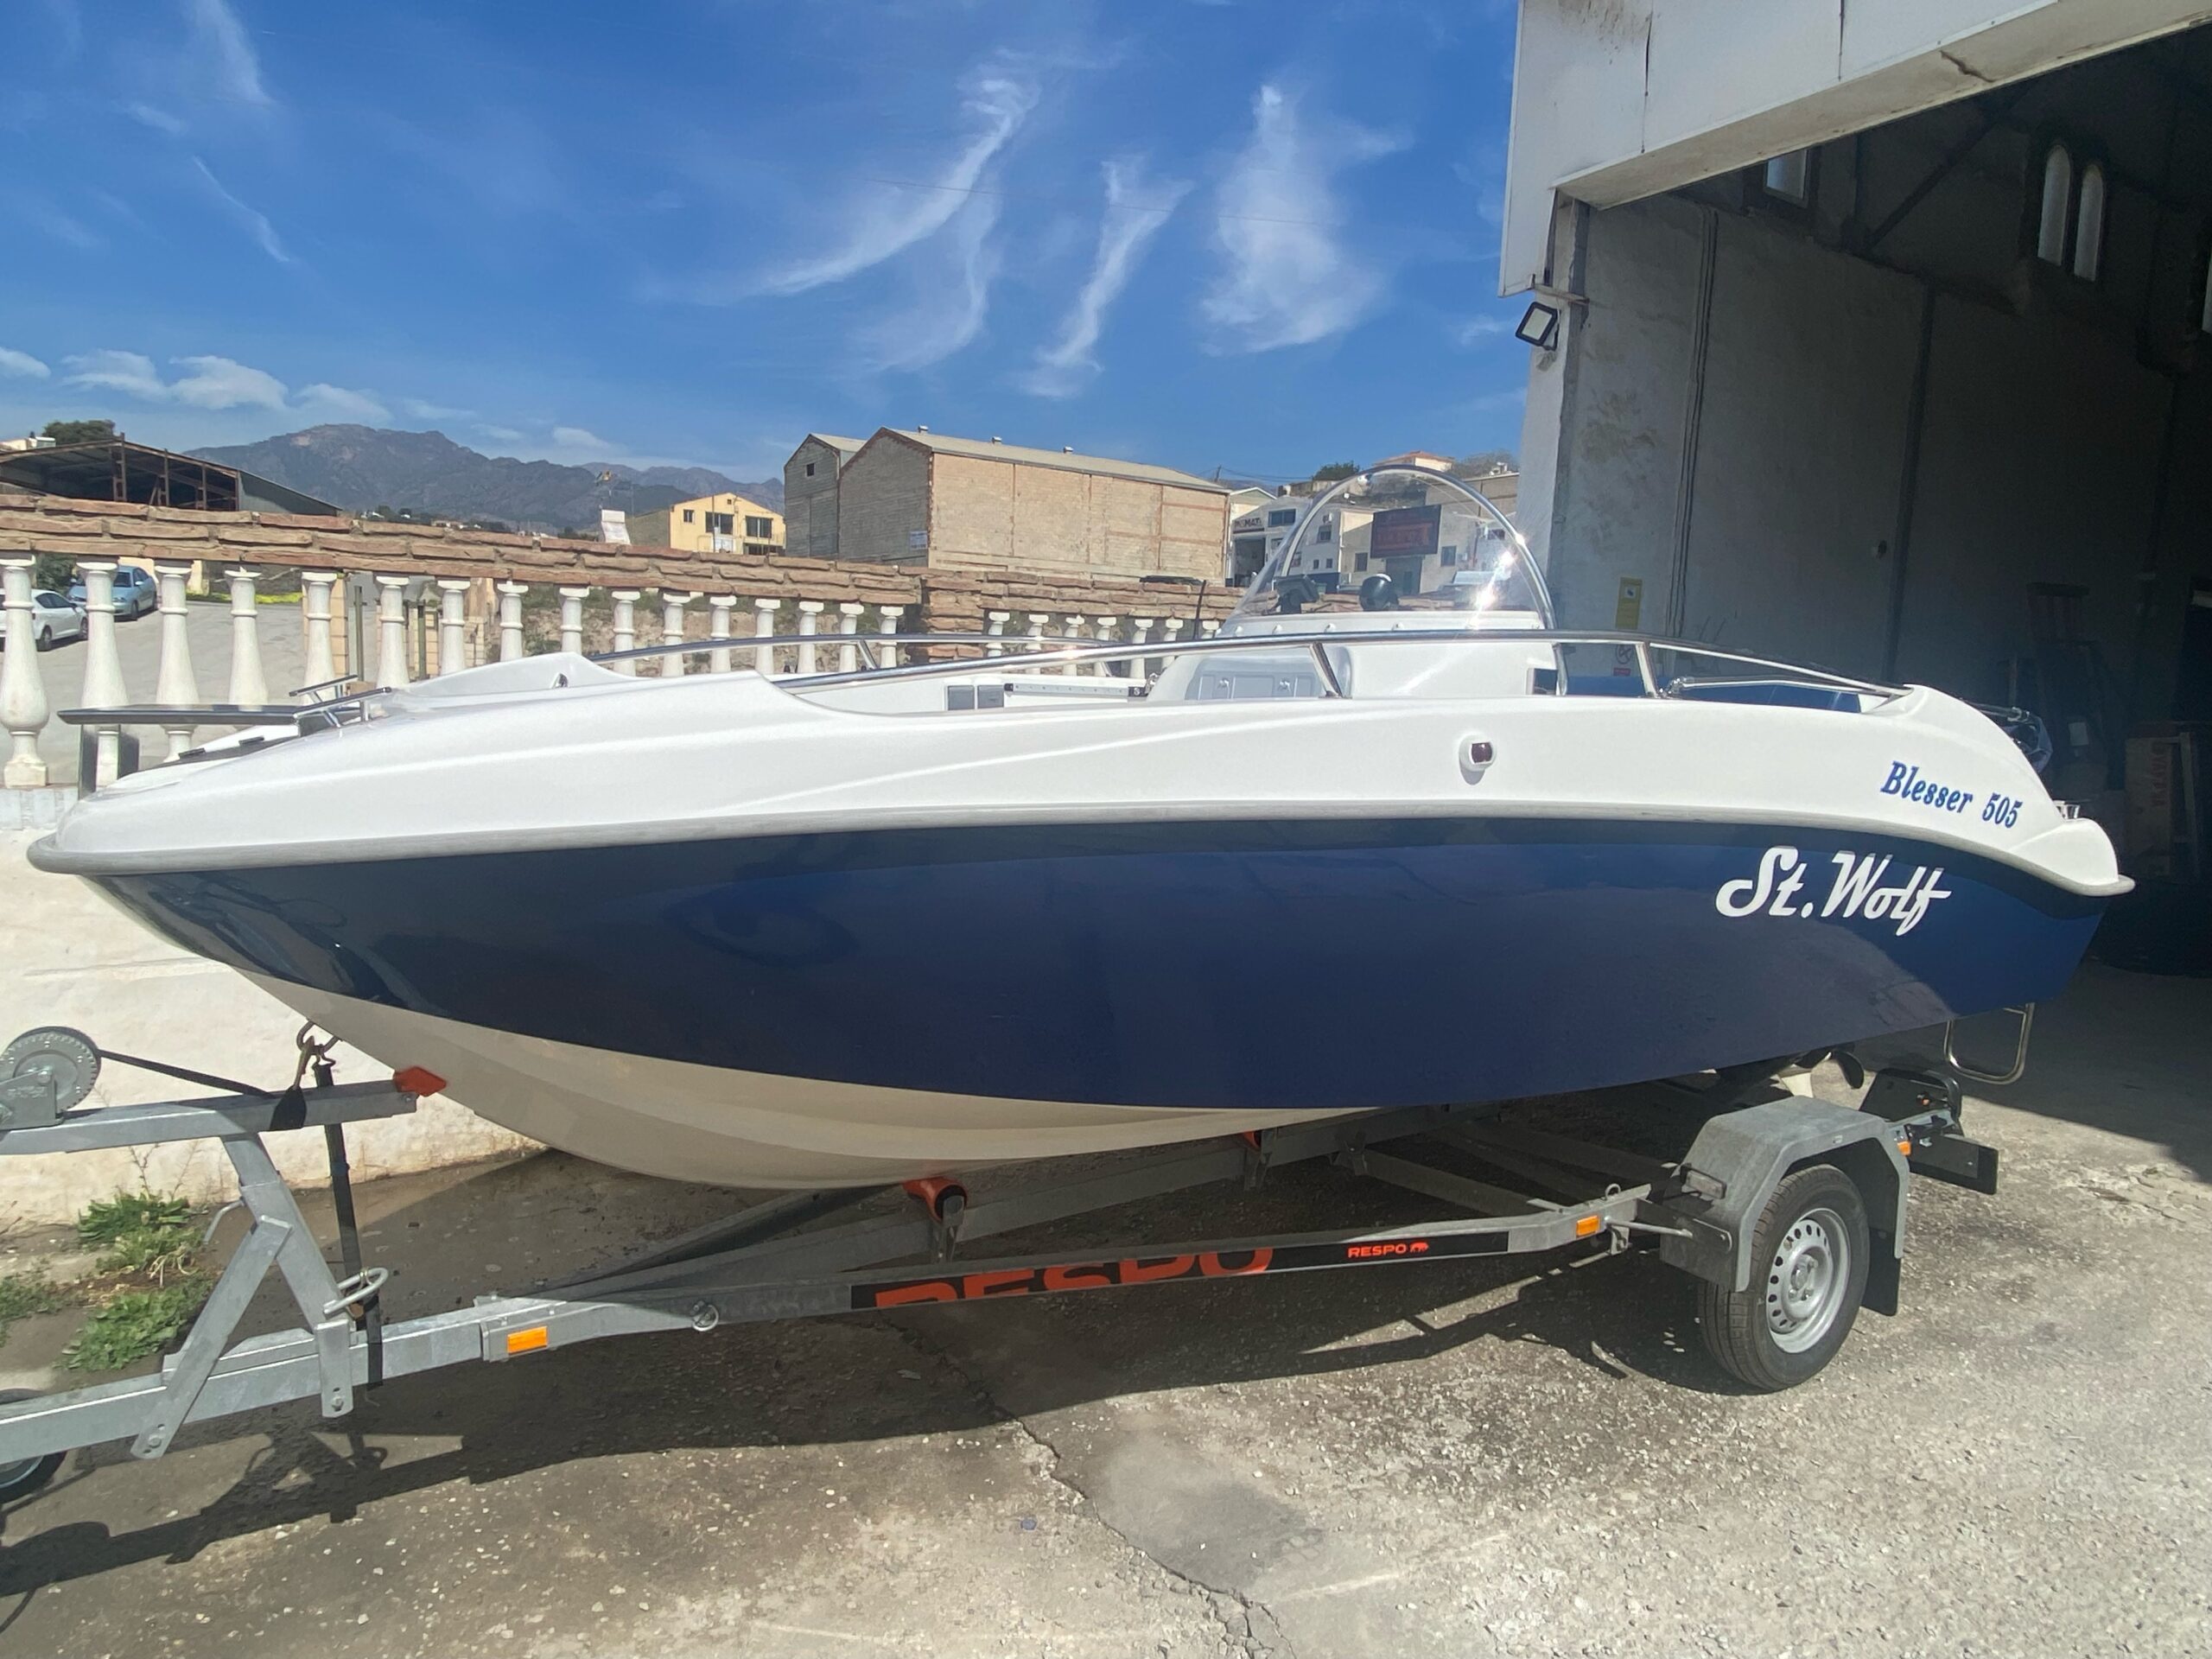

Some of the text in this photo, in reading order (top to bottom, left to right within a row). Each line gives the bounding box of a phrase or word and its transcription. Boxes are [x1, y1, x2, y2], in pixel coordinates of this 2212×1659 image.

[1880, 760, 2024, 829] Blesser 505
[1347, 1243, 1407, 1258] RESPO
